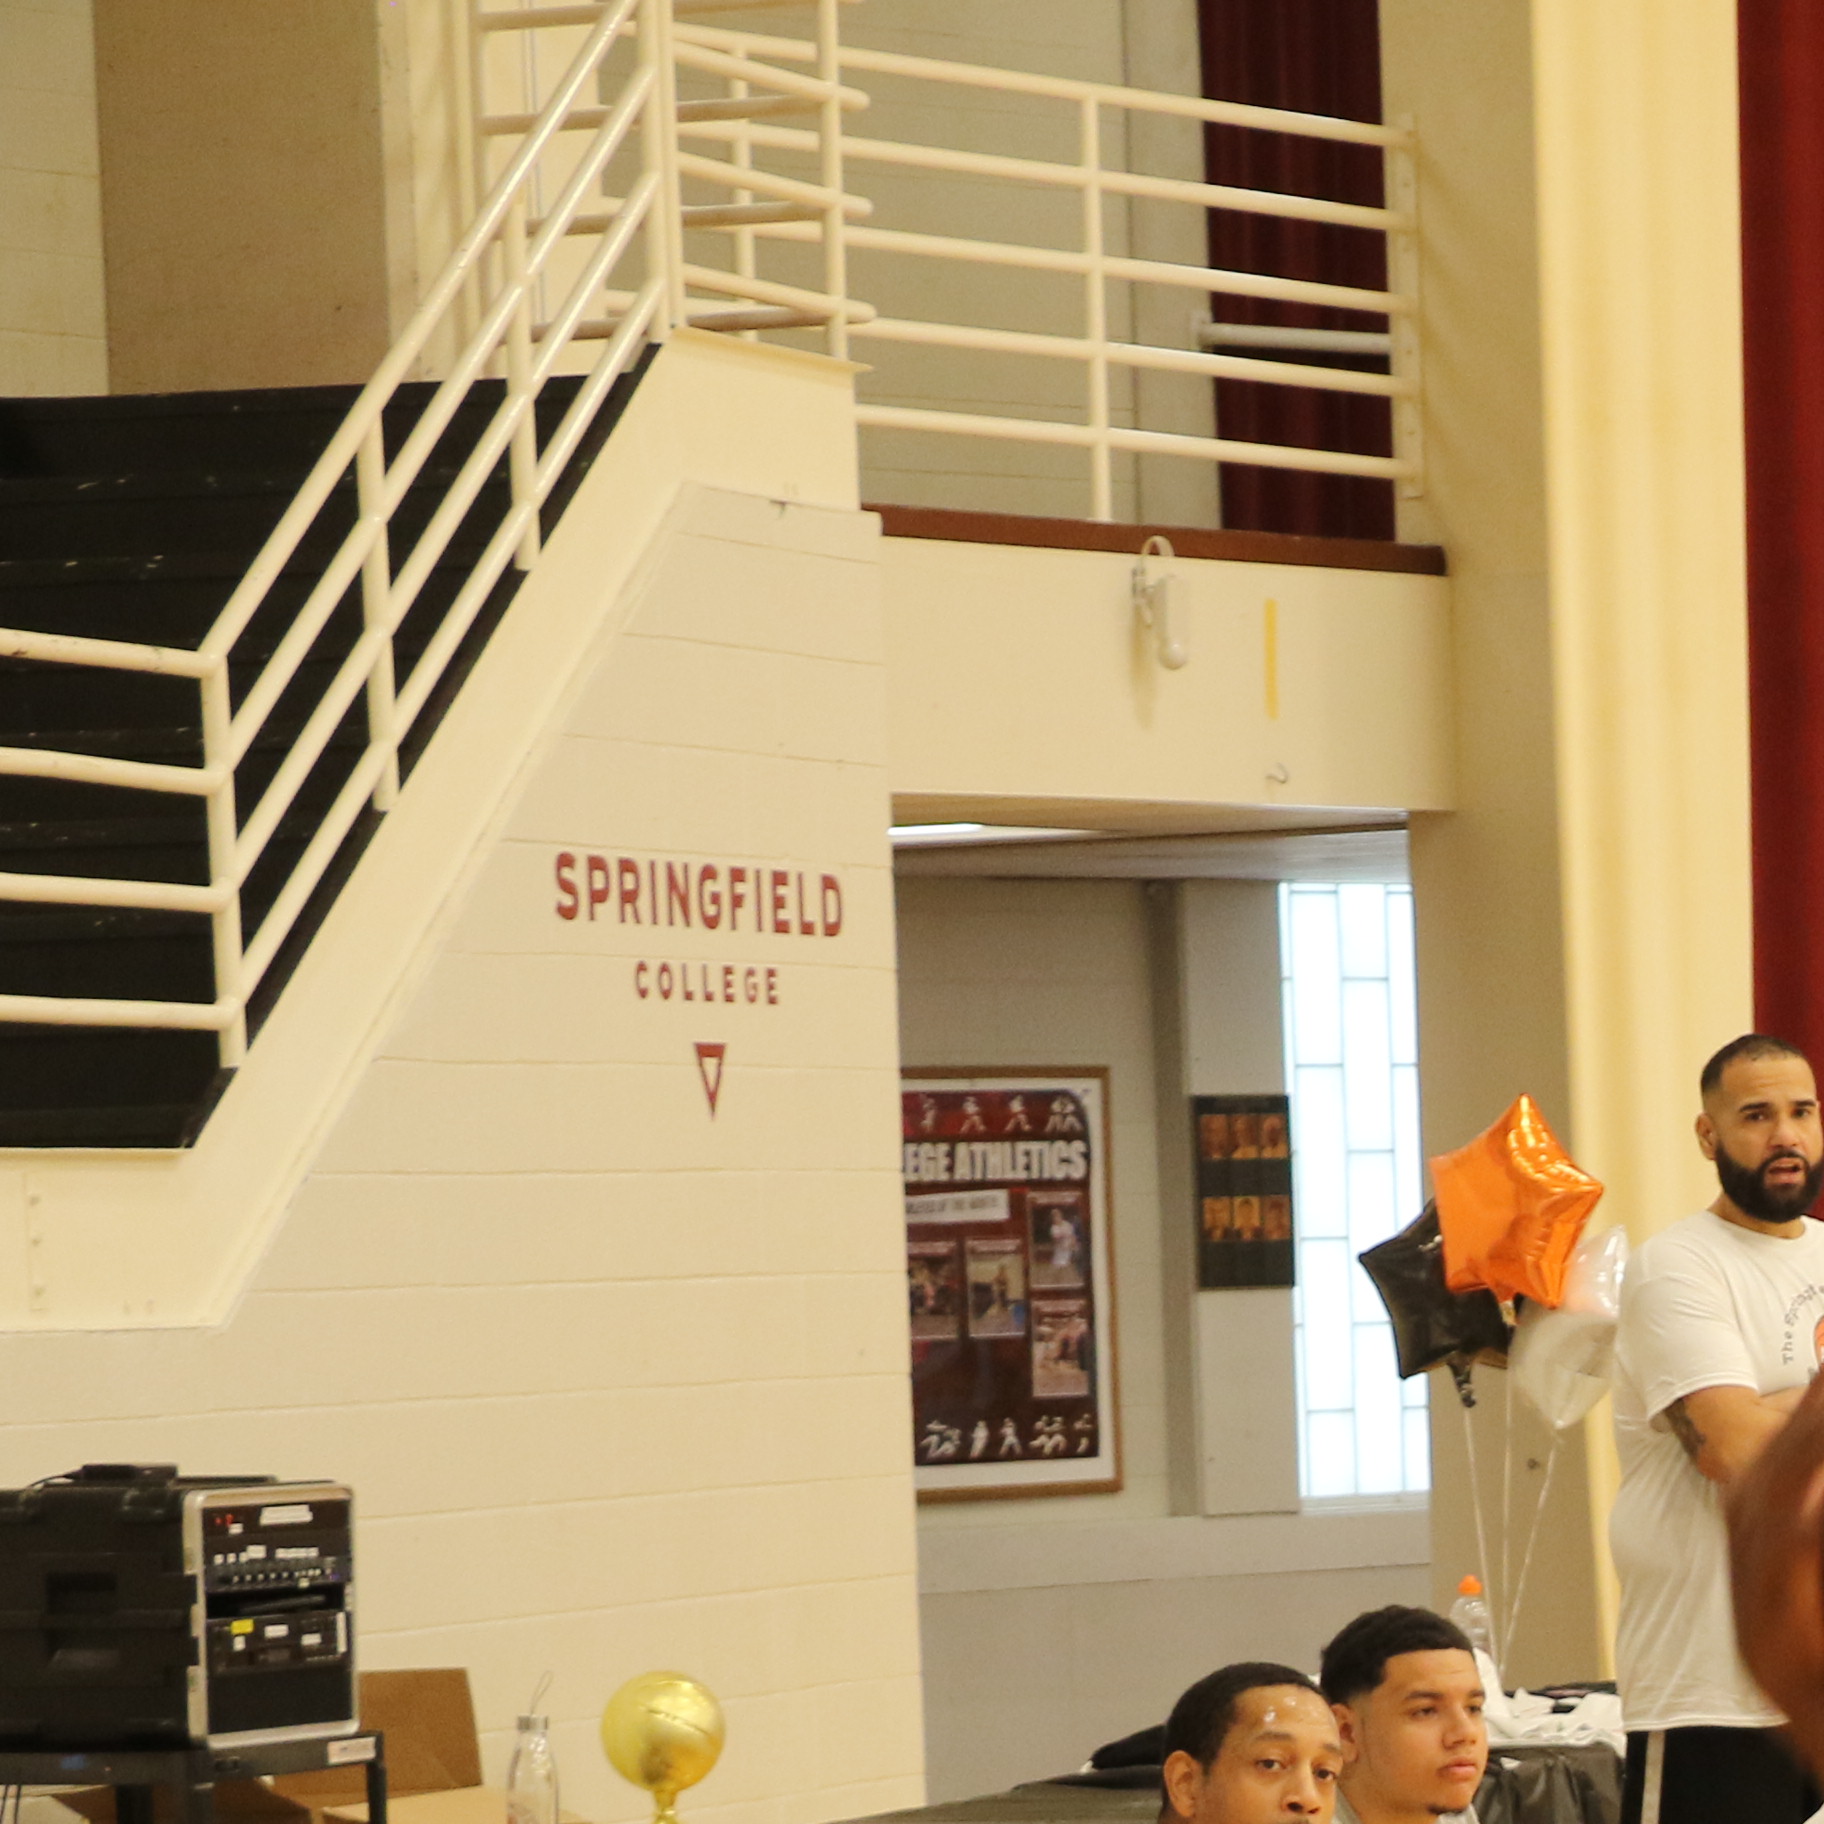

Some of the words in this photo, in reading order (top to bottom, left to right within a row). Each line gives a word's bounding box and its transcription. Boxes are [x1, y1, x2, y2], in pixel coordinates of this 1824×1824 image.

[555, 851, 843, 938] SPRINGFIELD
[634, 959, 779, 1005] COLLEGE
[952, 1139, 1088, 1181] ATHLETICS
